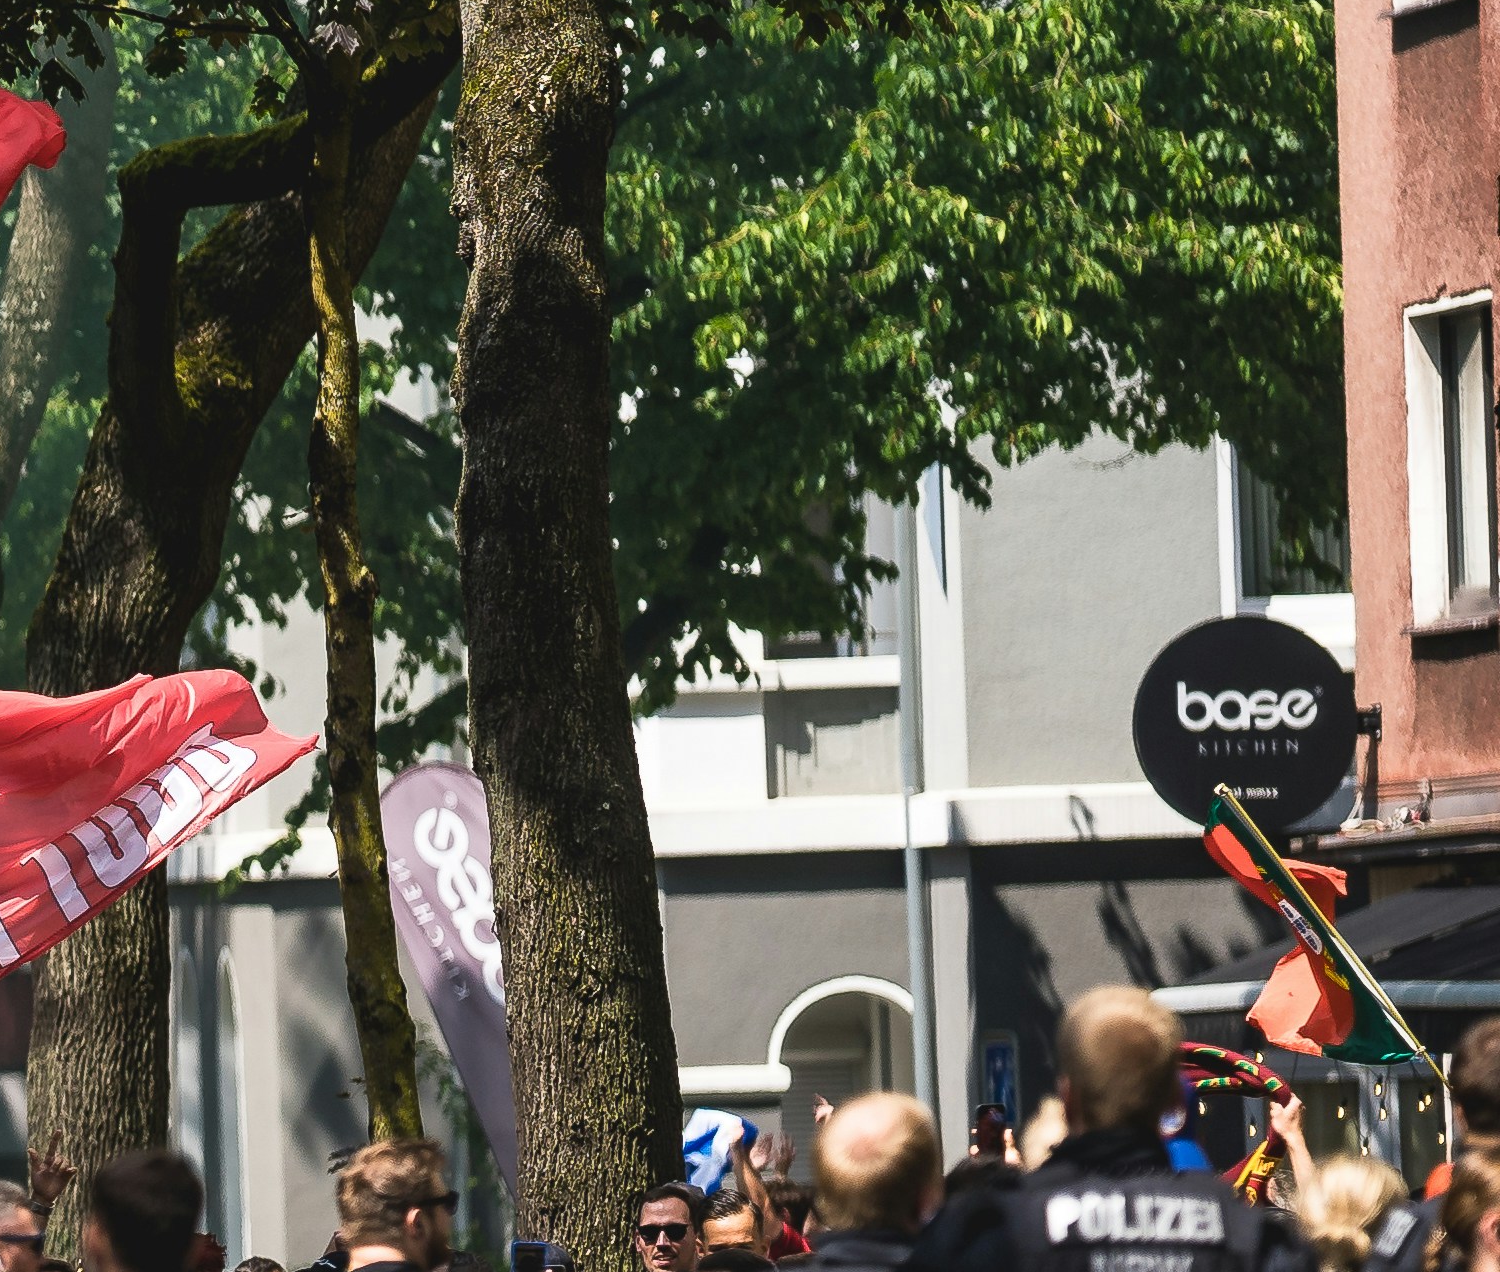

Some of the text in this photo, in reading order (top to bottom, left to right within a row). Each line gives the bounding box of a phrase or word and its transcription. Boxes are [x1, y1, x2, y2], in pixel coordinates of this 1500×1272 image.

[1176, 680, 1318, 732] base
[1198, 738, 1299, 757] KITCHEN
[390, 856, 471, 1002] KITCHEN
[1047, 1192, 1226, 1245] POLIZEI
